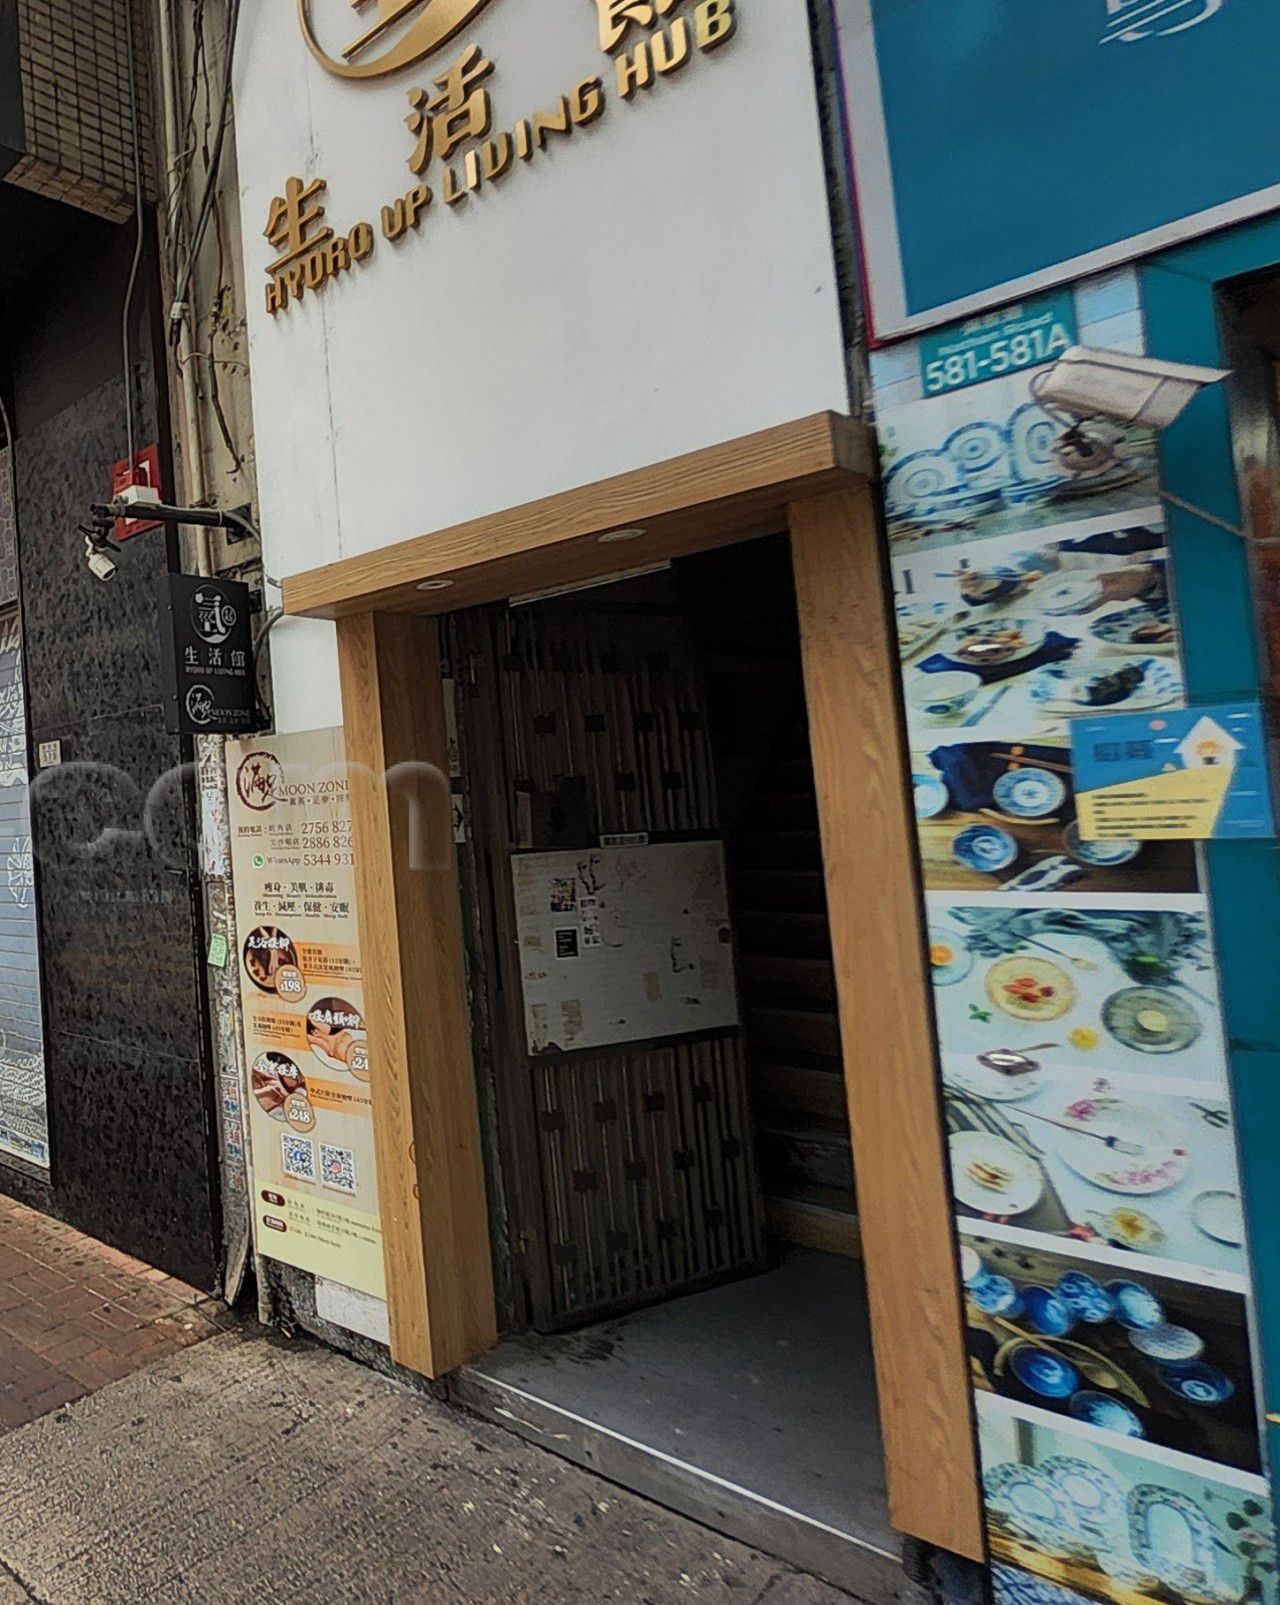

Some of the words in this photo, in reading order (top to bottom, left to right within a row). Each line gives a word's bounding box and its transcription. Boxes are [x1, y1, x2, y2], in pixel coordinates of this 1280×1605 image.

[265, 221, 373, 314] HYDRO
[381, 184, 432, 240] UP
[443, 73, 608, 205] LIVING
[614, 0, 735, 99] HUB
[925, 322, 1071, 391] 581-581A
[279, 782, 316, 797] MOON
[301, 823, 330, 836] 2756
[302, 836, 331, 849] 2886
[303, 854, 332, 867] 5344
